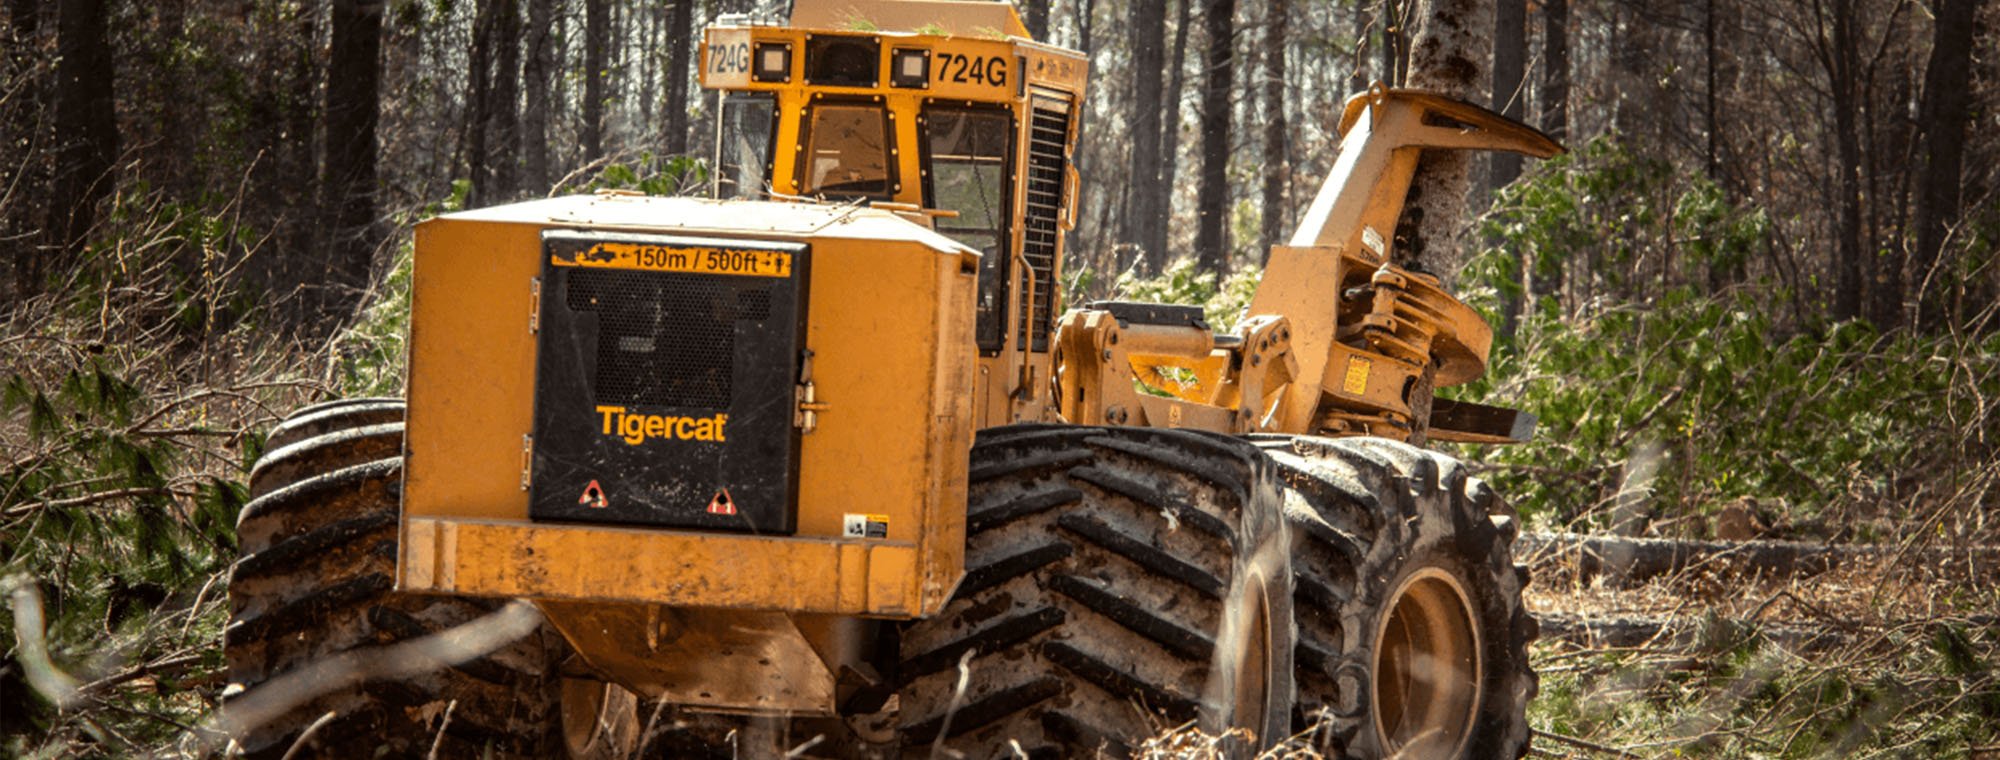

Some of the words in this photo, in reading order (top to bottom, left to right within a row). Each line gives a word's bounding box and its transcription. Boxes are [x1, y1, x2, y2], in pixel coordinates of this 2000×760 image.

[708, 42, 749, 73] 724G
[936, 52, 1007, 87] 724G
[633, 248, 686, 269] 150m
[692, 251, 700, 269] /
[707, 250, 758, 273] 500ft
[596, 405, 728, 446] Tigercat
